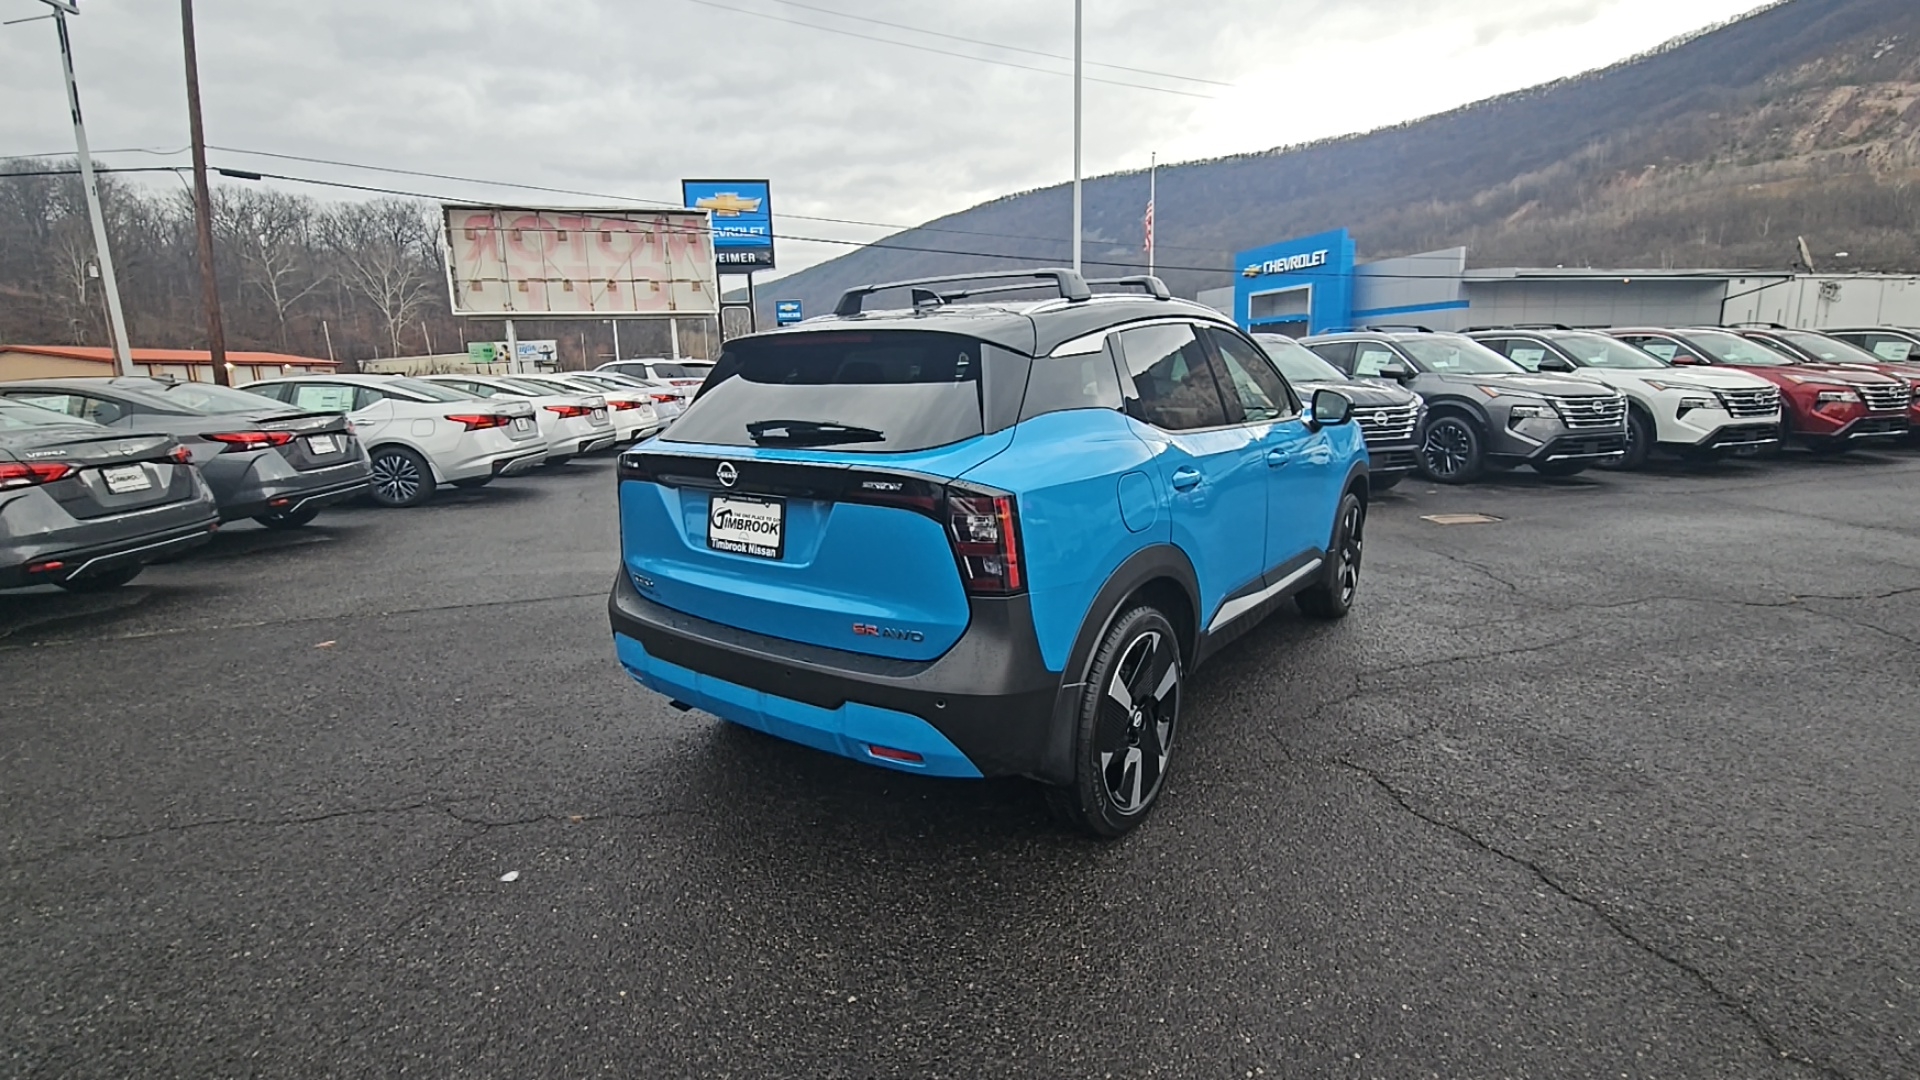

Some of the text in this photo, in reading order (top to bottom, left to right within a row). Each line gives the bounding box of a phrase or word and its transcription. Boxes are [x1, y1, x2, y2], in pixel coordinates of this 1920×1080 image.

[712, 226, 765, 237] EVROLET
[715, 252, 756, 263] EIMER
[1263, 249, 1328, 274] CHEVROLET
[712, 507, 779, 535] TIMBROOK
[712, 538, 776, 557] Timbrook Nissan
[882, 627, 924, 642] AWD
